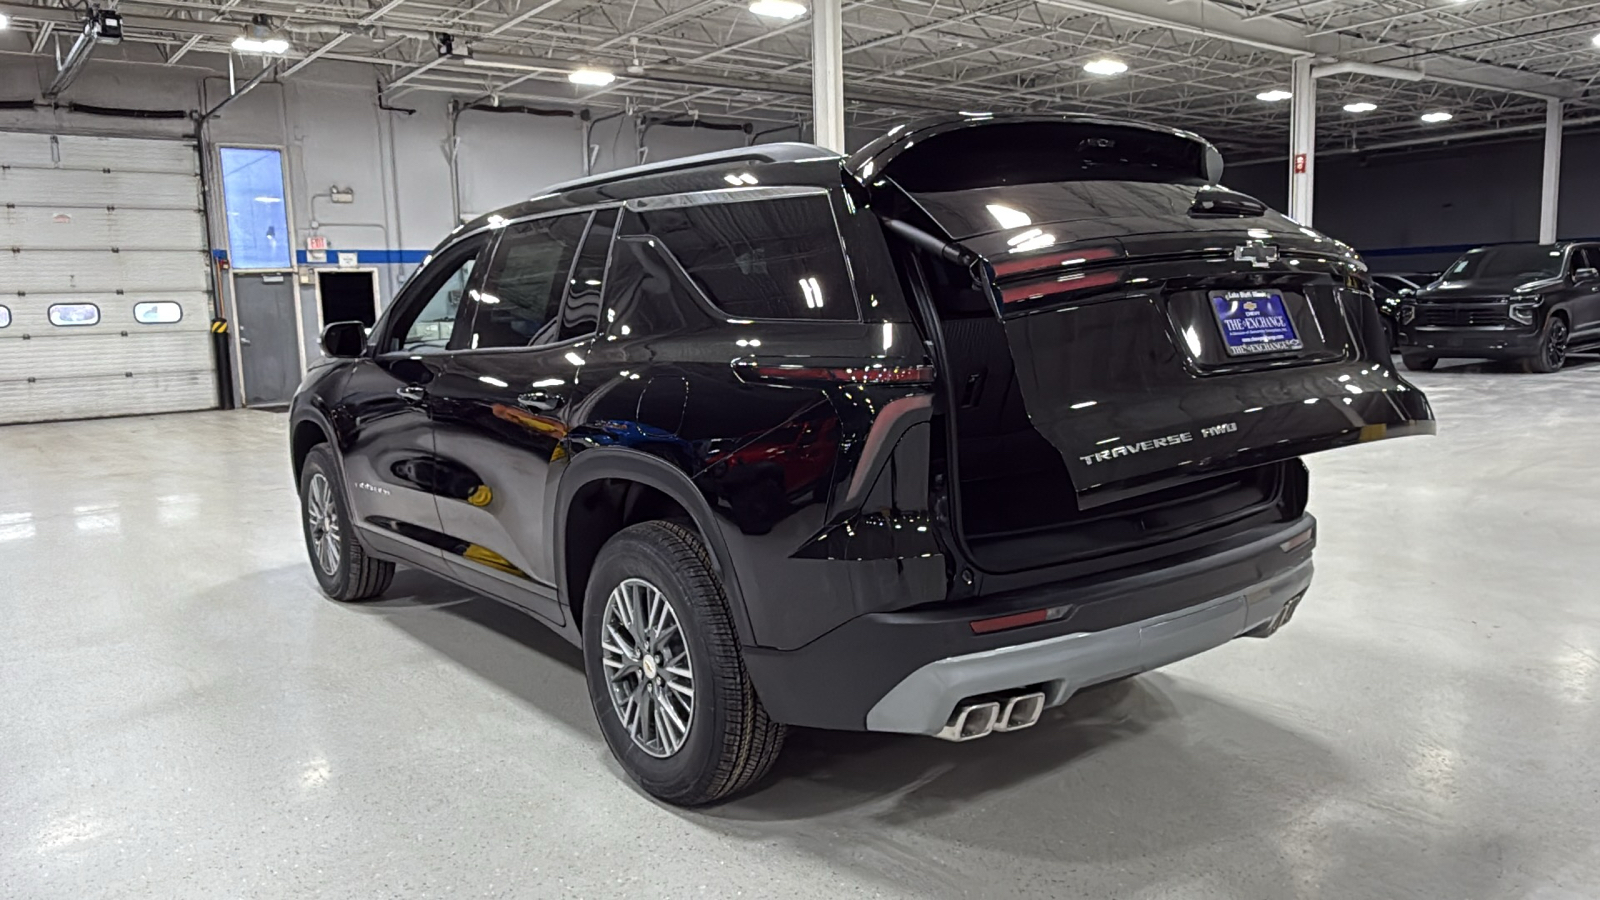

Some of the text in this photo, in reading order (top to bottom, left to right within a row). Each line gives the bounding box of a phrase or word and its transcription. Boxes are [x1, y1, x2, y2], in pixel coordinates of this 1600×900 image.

[1224, 316, 1286, 331] THE EXCHANGE
[1230, 344, 1247, 354] THE
[1080, 422, 1237, 465] TRAVERSE AWD
